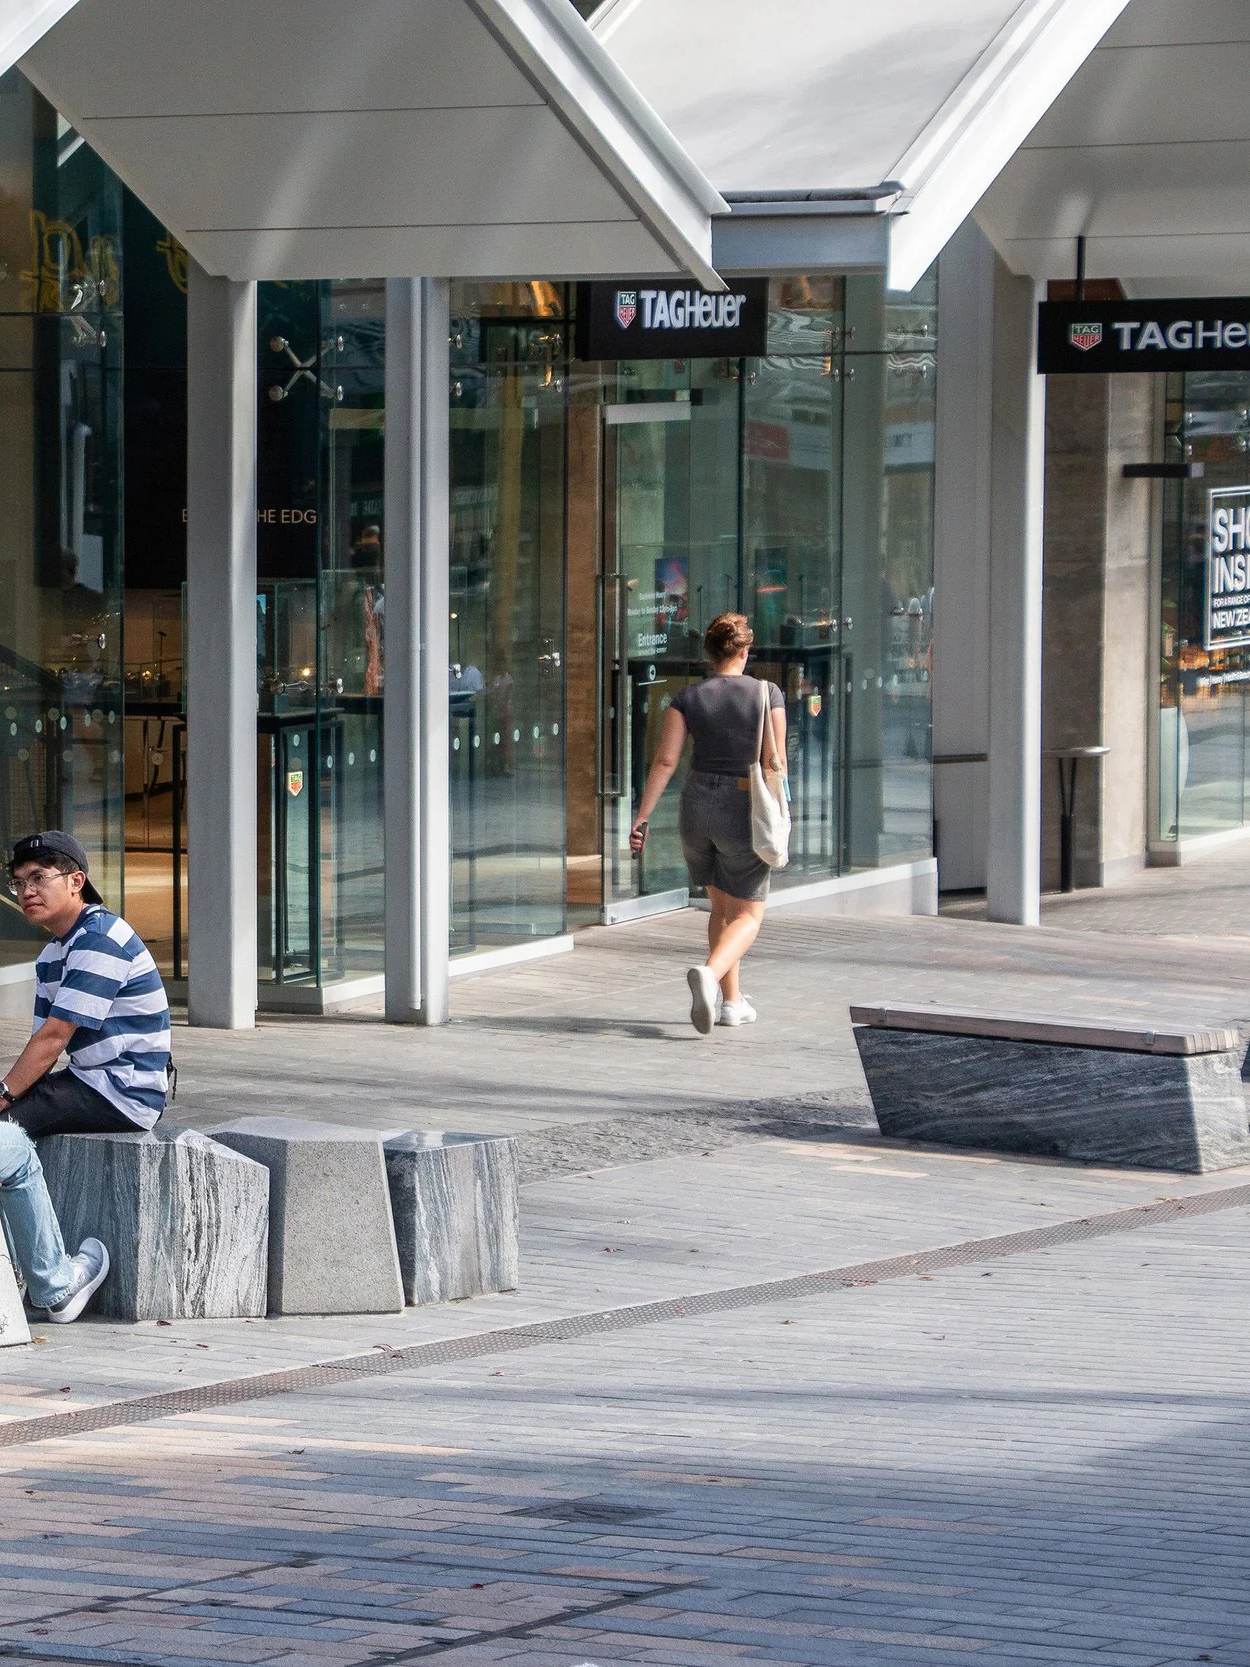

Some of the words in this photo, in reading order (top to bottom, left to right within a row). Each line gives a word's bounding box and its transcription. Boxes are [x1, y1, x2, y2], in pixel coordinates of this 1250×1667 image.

[621, 294, 635, 305] TAG
[641, 290, 747, 328] TAGHeuer
[1074, 325, 1099, 334] TAG
[1114, 320, 1250, 350] TAGHe
[1073, 335, 1100, 347] HEUER
[1213, 506, 1250, 552] SH
[1213, 610, 1235, 629] NEW
[637, 633, 668, 647] Entrance
